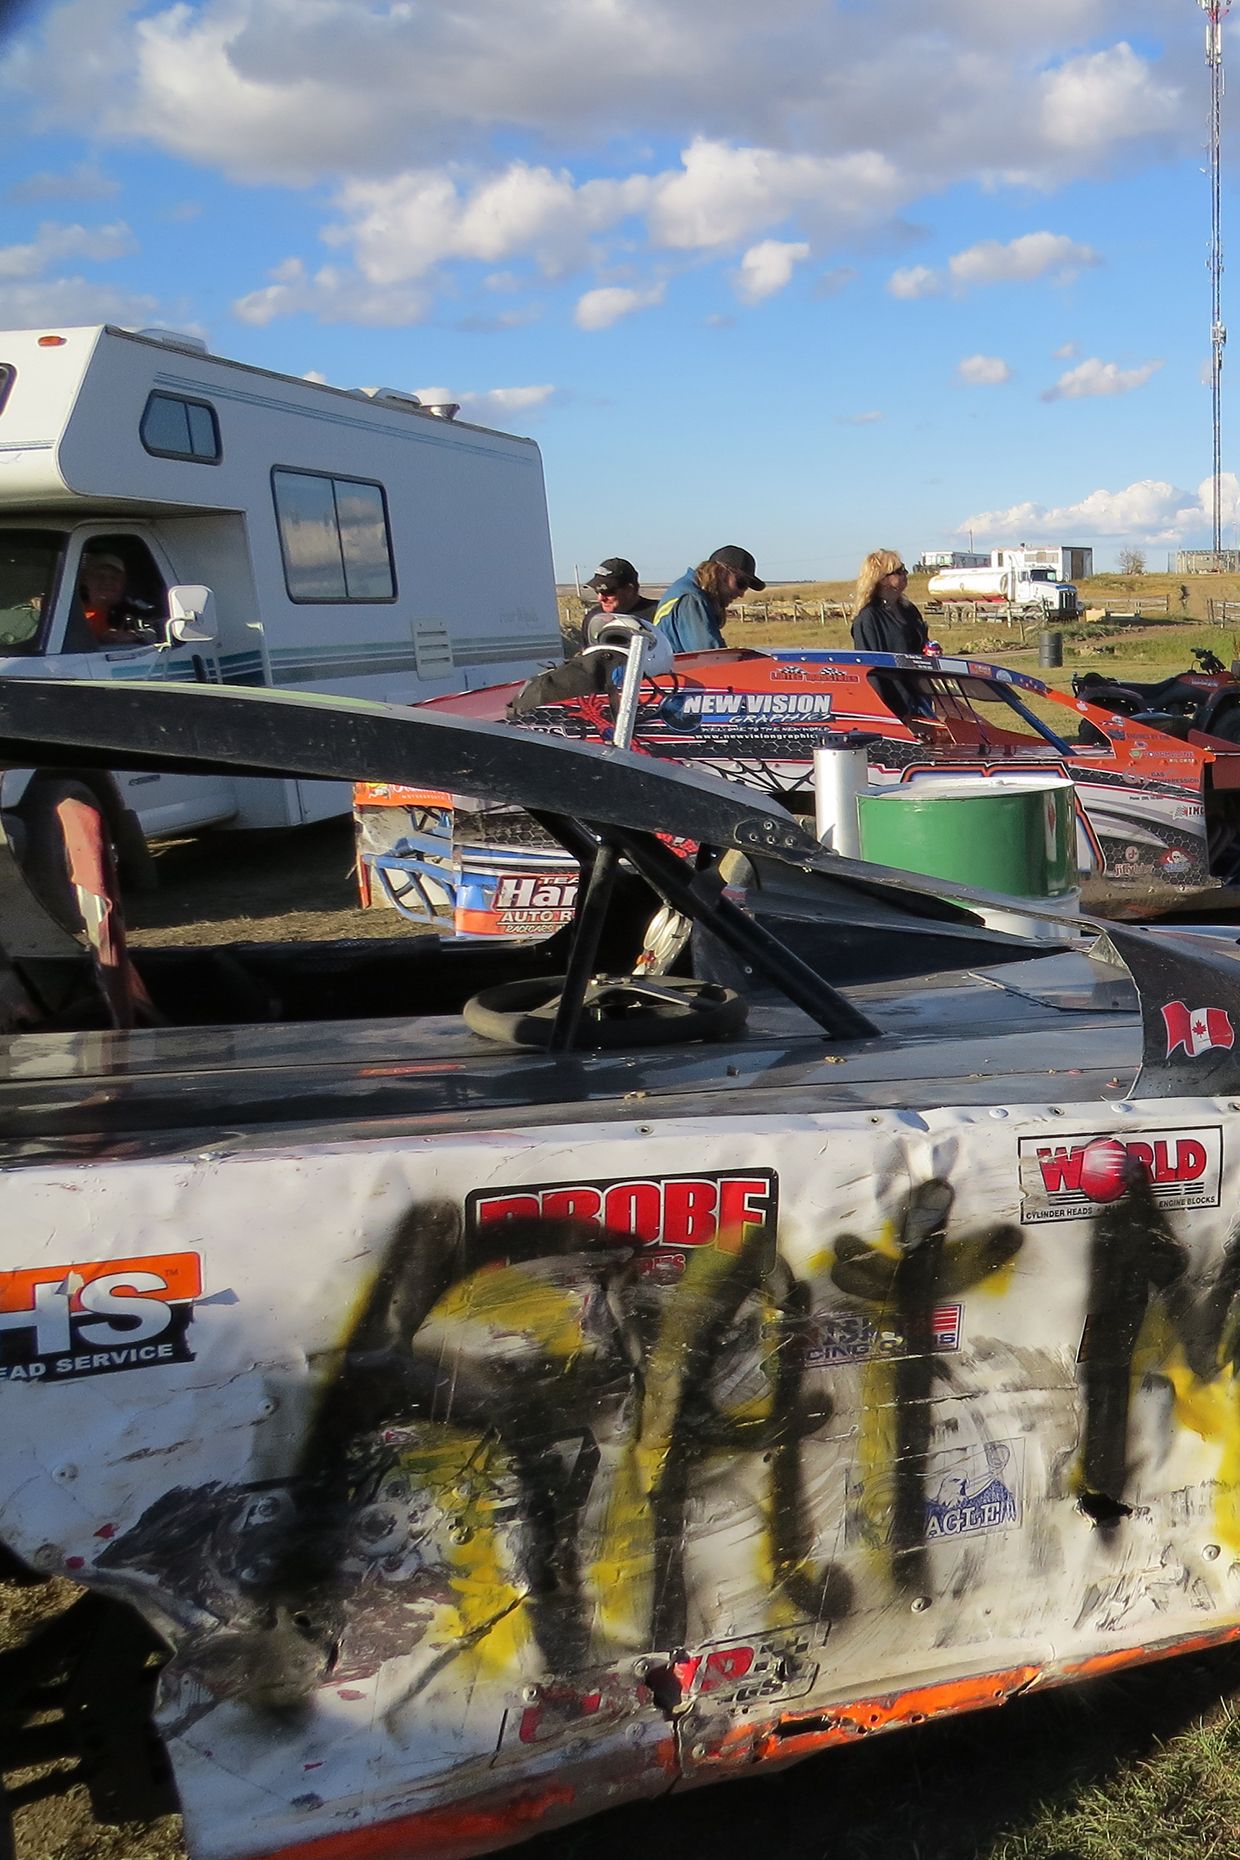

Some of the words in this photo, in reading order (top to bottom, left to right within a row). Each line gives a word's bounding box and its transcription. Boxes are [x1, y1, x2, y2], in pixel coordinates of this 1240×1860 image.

[683, 694, 743, 714] NEW
[748, 694, 832, 714] VISION
[729, 713, 831, 724] GRAPHICS
[501, 912, 554, 922] AUTO
[1036, 1137, 1207, 1198] WORLD
[1158, 1198, 1186, 1208] ENGINE
[1187, 1195, 1216, 1205] BLOCKS
[1026, 1208, 1066, 1219] CYLINDER
[1067, 1206, 1093, 1216] HEADS
[56, 1343, 174, 1373] SERVICE
[924, 1501, 1001, 1539] AGLE
